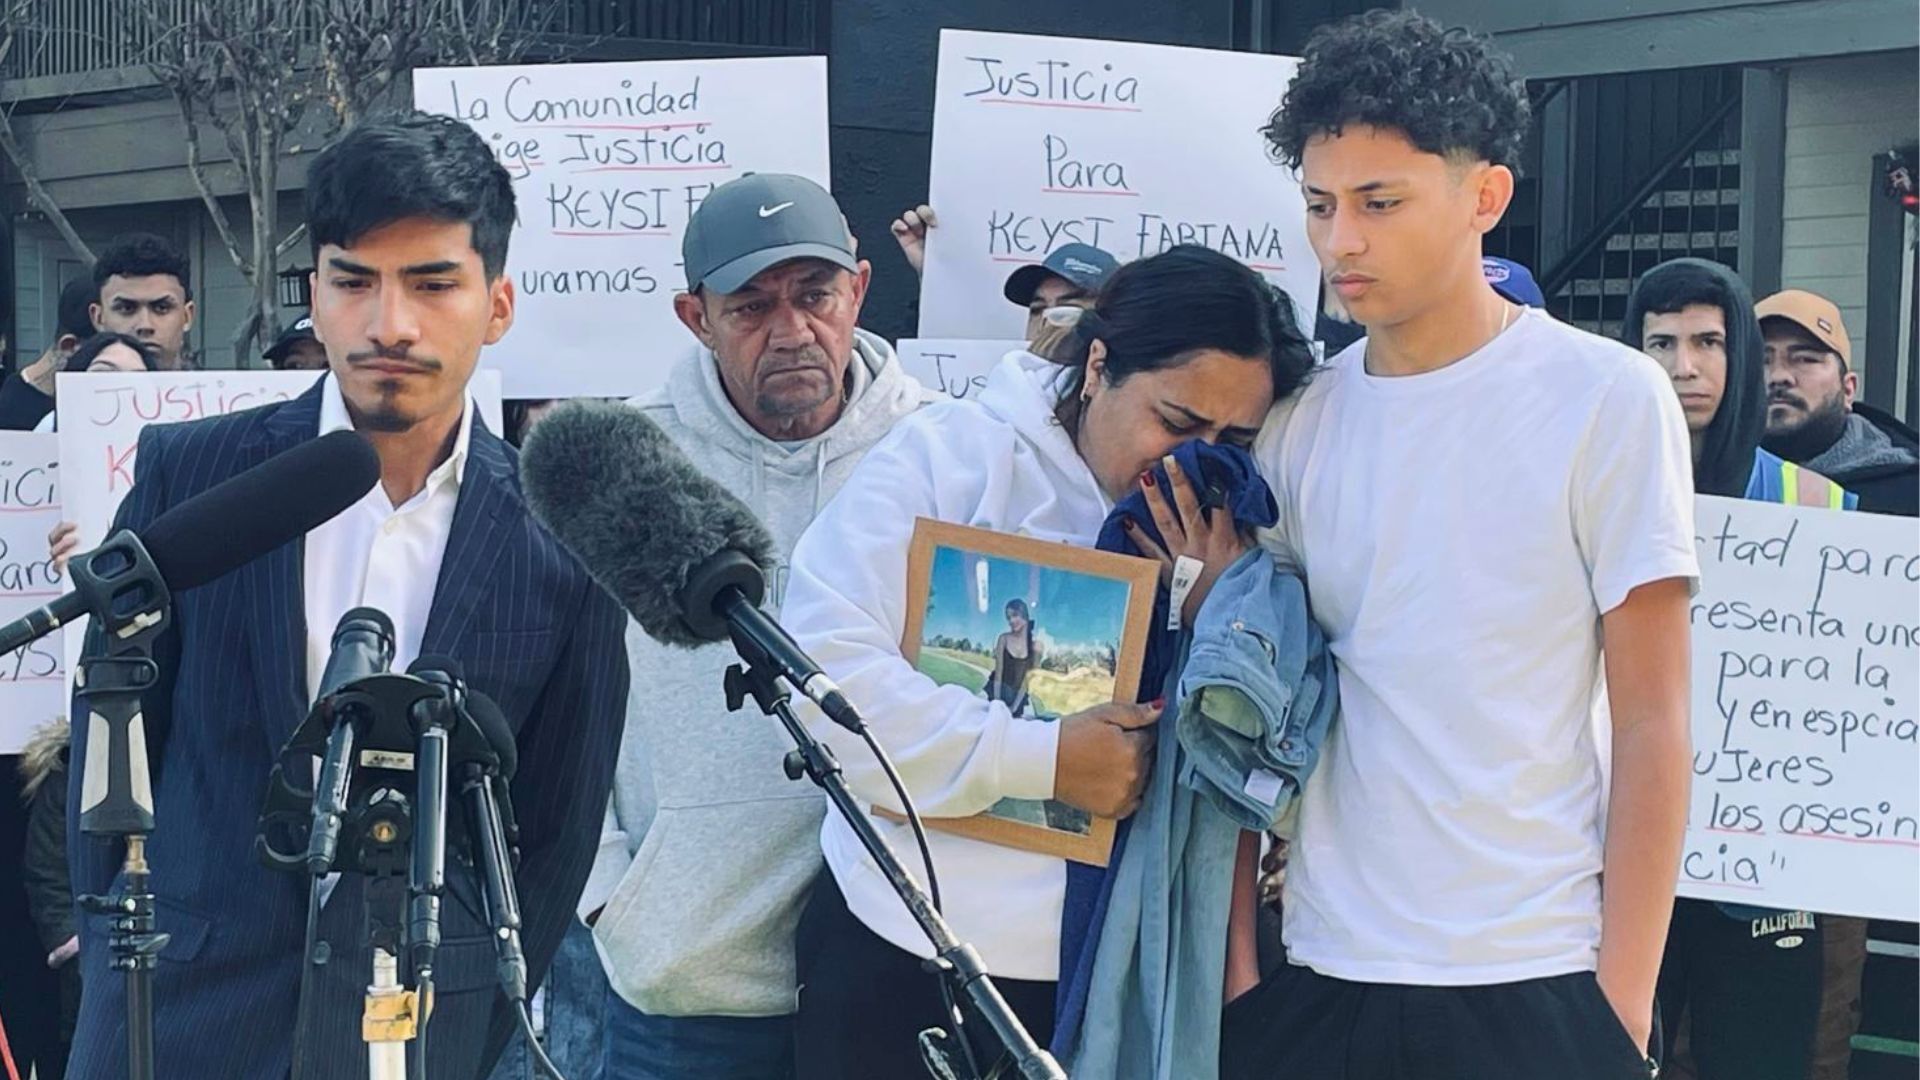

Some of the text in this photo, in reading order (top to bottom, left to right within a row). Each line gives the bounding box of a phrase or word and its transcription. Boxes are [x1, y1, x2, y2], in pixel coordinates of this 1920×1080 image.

[505, 76, 700, 122] Comunidad
[492, 133, 540, 180] ige
[1043, 134, 1129, 190] Para
[546, 183, 671, 230] KEYSI
[1690, 600, 1845, 639] resenta
[1717, 647, 1890, 702] para la
[1803, 696, 1919, 753] espcia
[1709, 792, 1918, 839] los asesin
